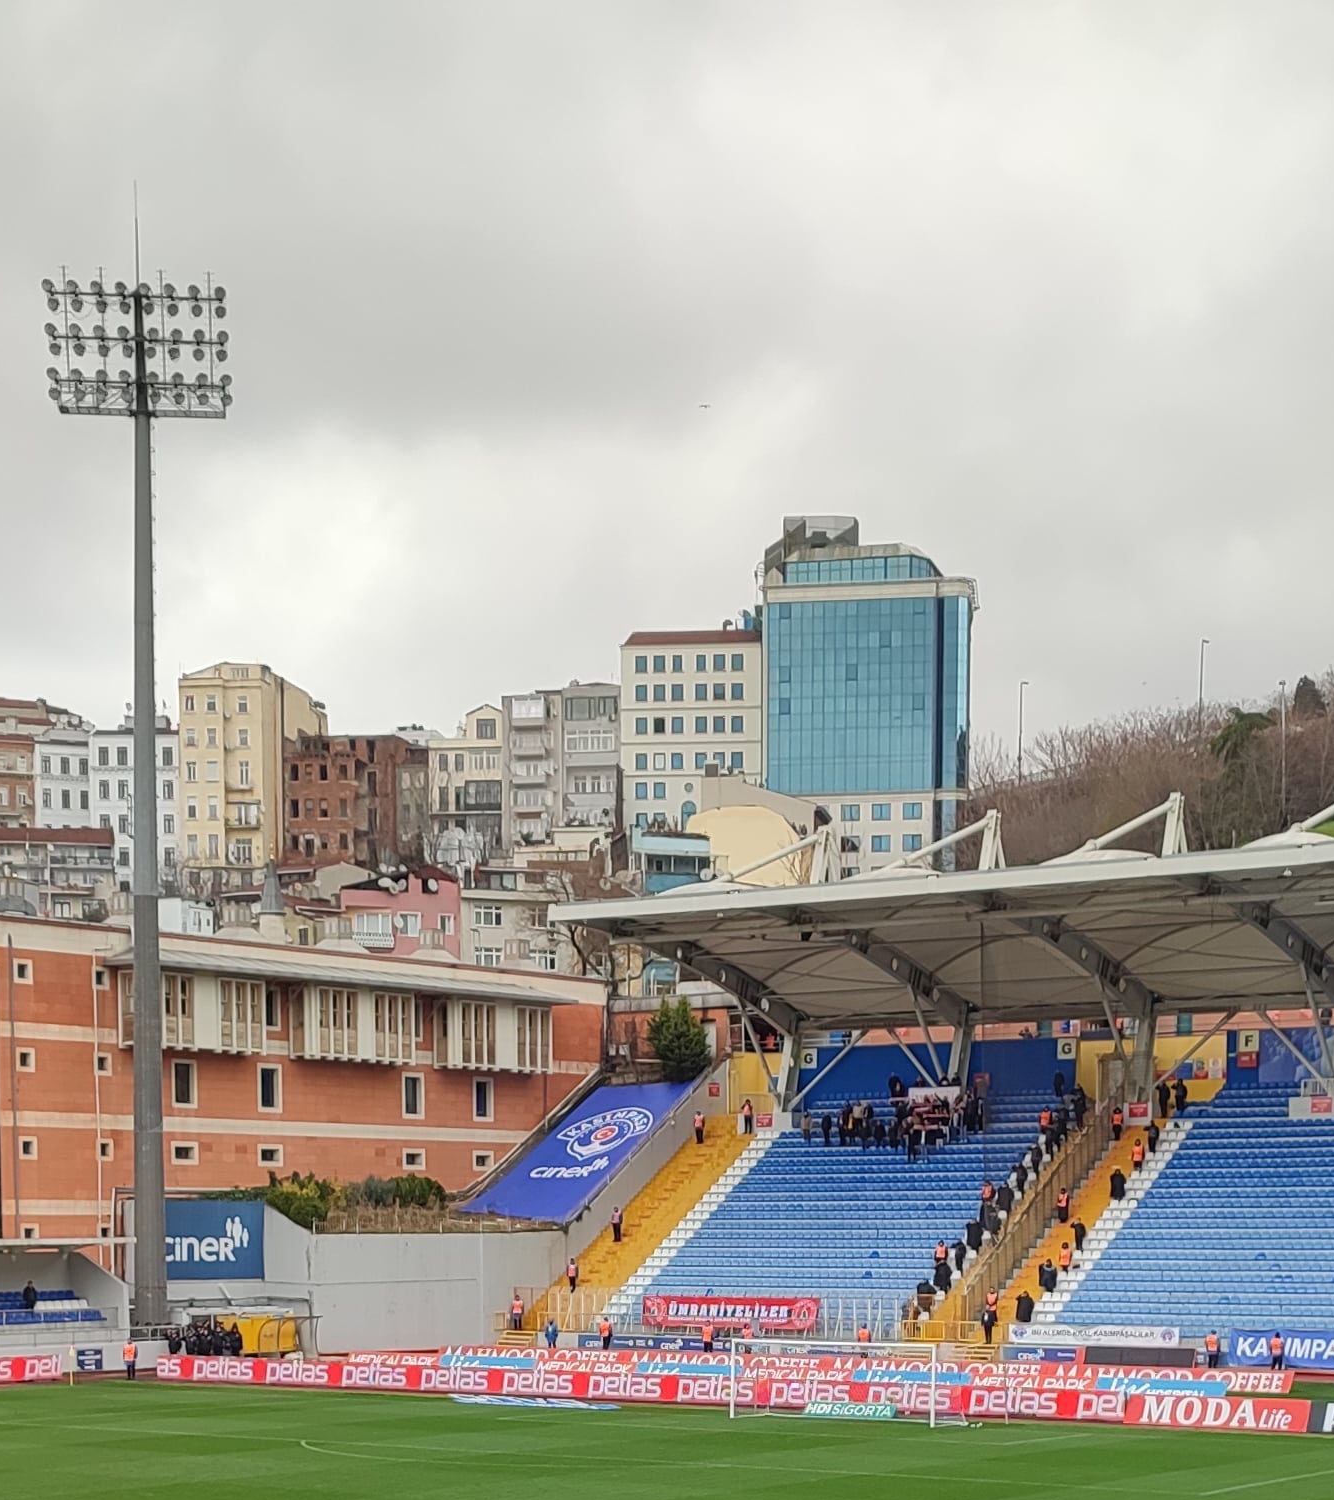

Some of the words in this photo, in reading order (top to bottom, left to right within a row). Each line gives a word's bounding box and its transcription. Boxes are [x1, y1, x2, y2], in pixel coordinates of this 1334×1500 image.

[1062, 1041, 1072, 1056] G
[1245, 1034, 1253, 1048] F
[803, 1052, 813, 1067] G
[668, 1300, 789, 1318] ÜMRANİYELİLER
[193, 1356, 254, 1384] petlas
[267, 1358, 329, 1386] petlas
[342, 1364, 407, 1388] petlas
[420, 1367, 489, 1391] petlas
[503, 1368, 574, 1394] petlas
[588, 1372, 662, 1398] petlas
[678, 1374, 755, 1401] petlas
[771, 1379, 851, 1405] petlas
[868, 1383, 952, 1411] petlas
[969, 1387, 1058, 1416] petlas
[1139, 1396, 1257, 1428] MODA
[1259, 1409, 1293, 1430] Life
